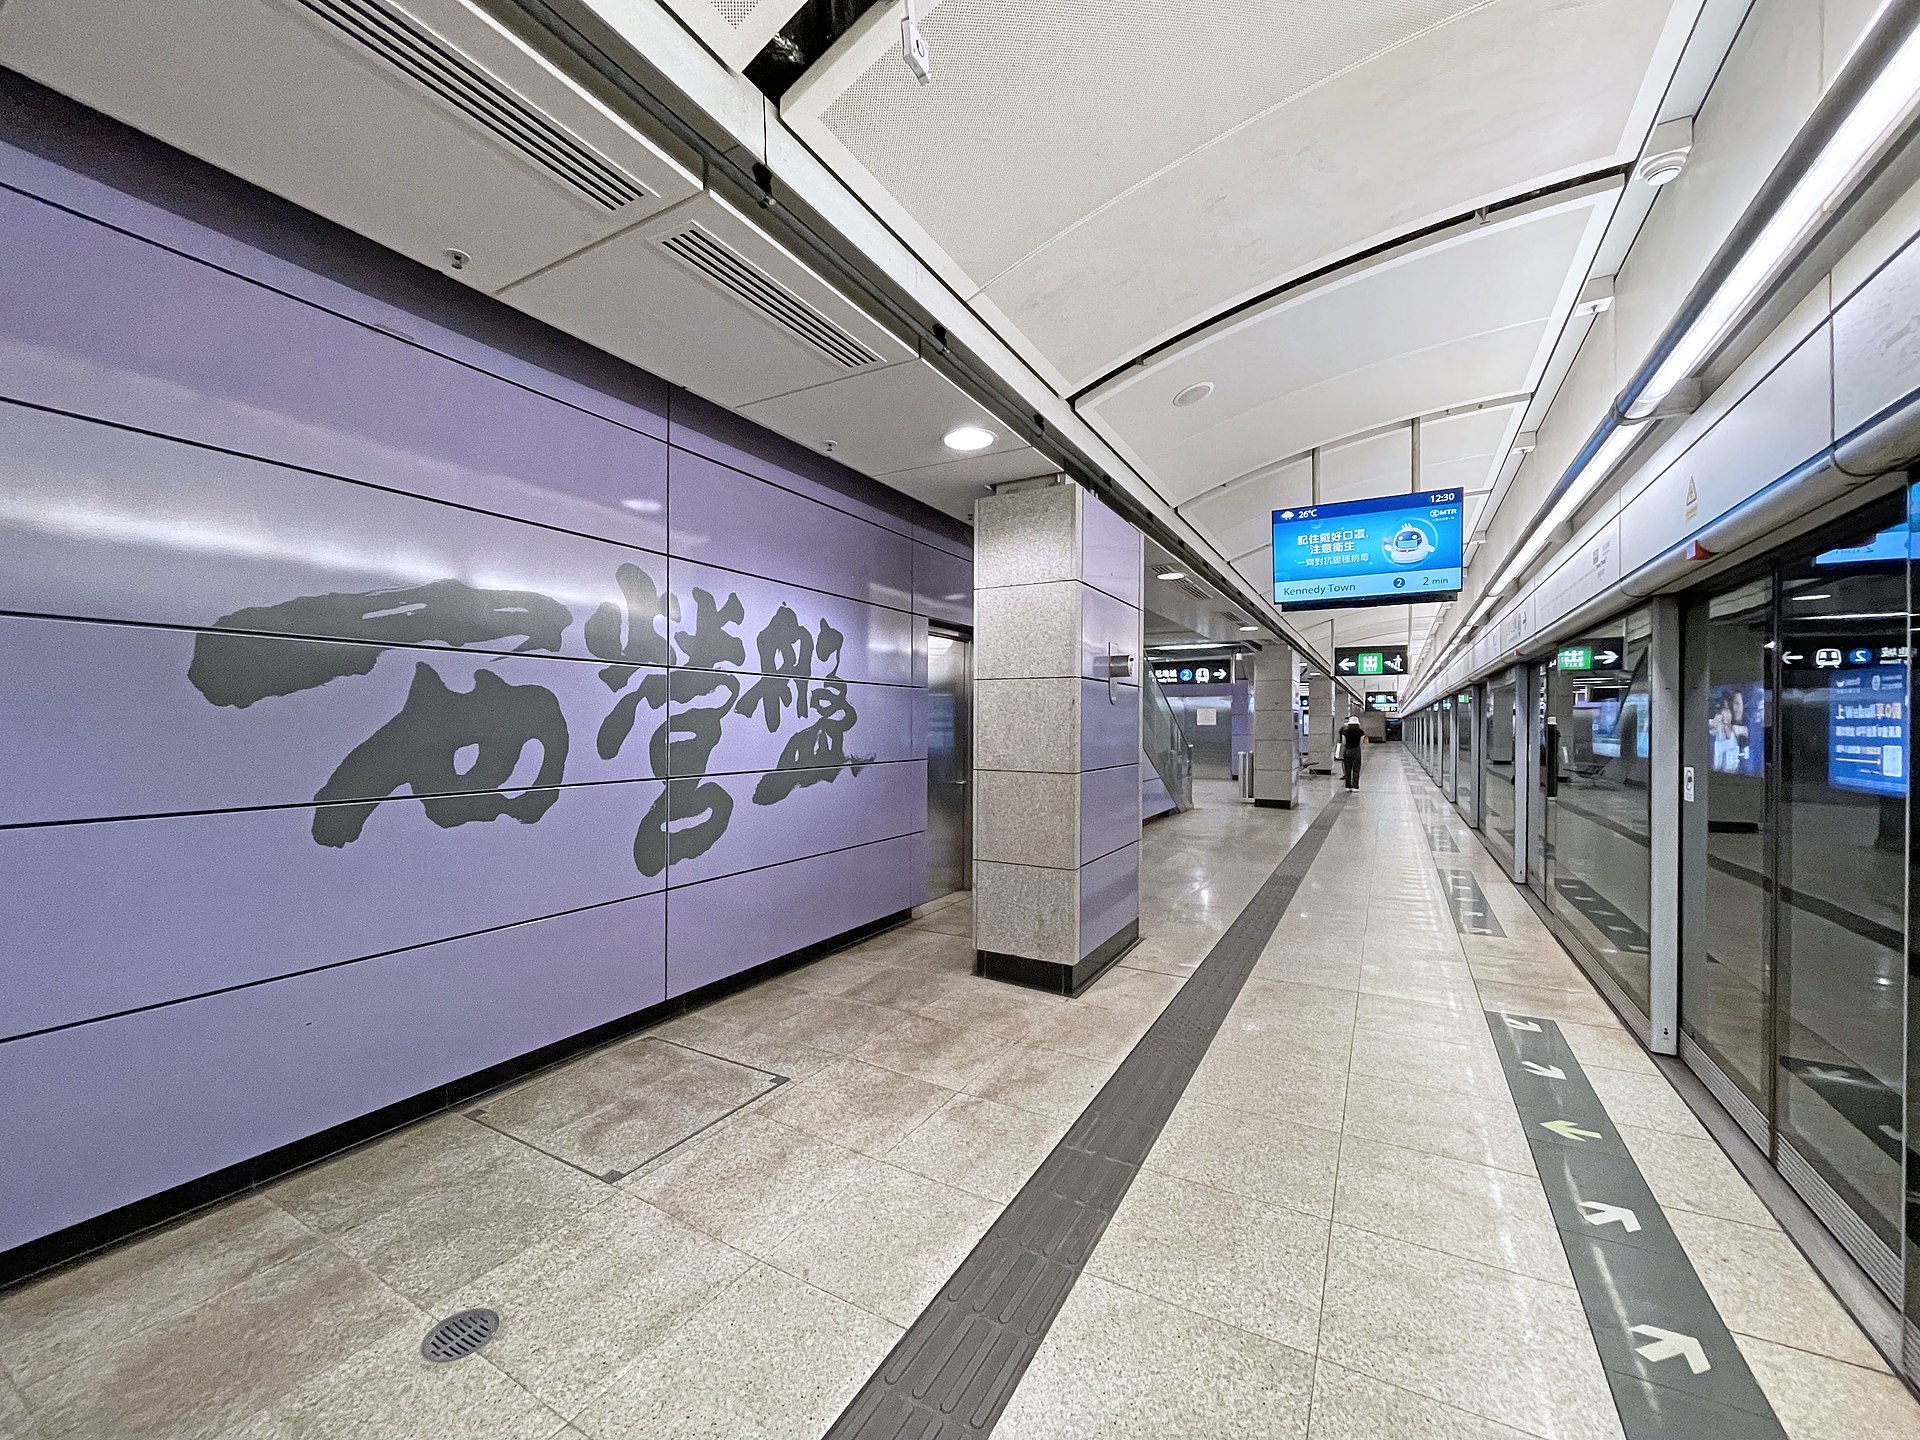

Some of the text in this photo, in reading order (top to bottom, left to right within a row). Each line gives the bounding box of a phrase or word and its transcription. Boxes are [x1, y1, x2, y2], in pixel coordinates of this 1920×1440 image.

[1430, 493, 1455, 503] 12:30
[1298, 509, 1318, 519] 26°C
[1440, 508, 1457, 517] MTR
[1422, 576, 1449, 586] 2 min
[1283, 583, 1356, 597] Kennedy Town
[1363, 656, 1378, 667] 出
